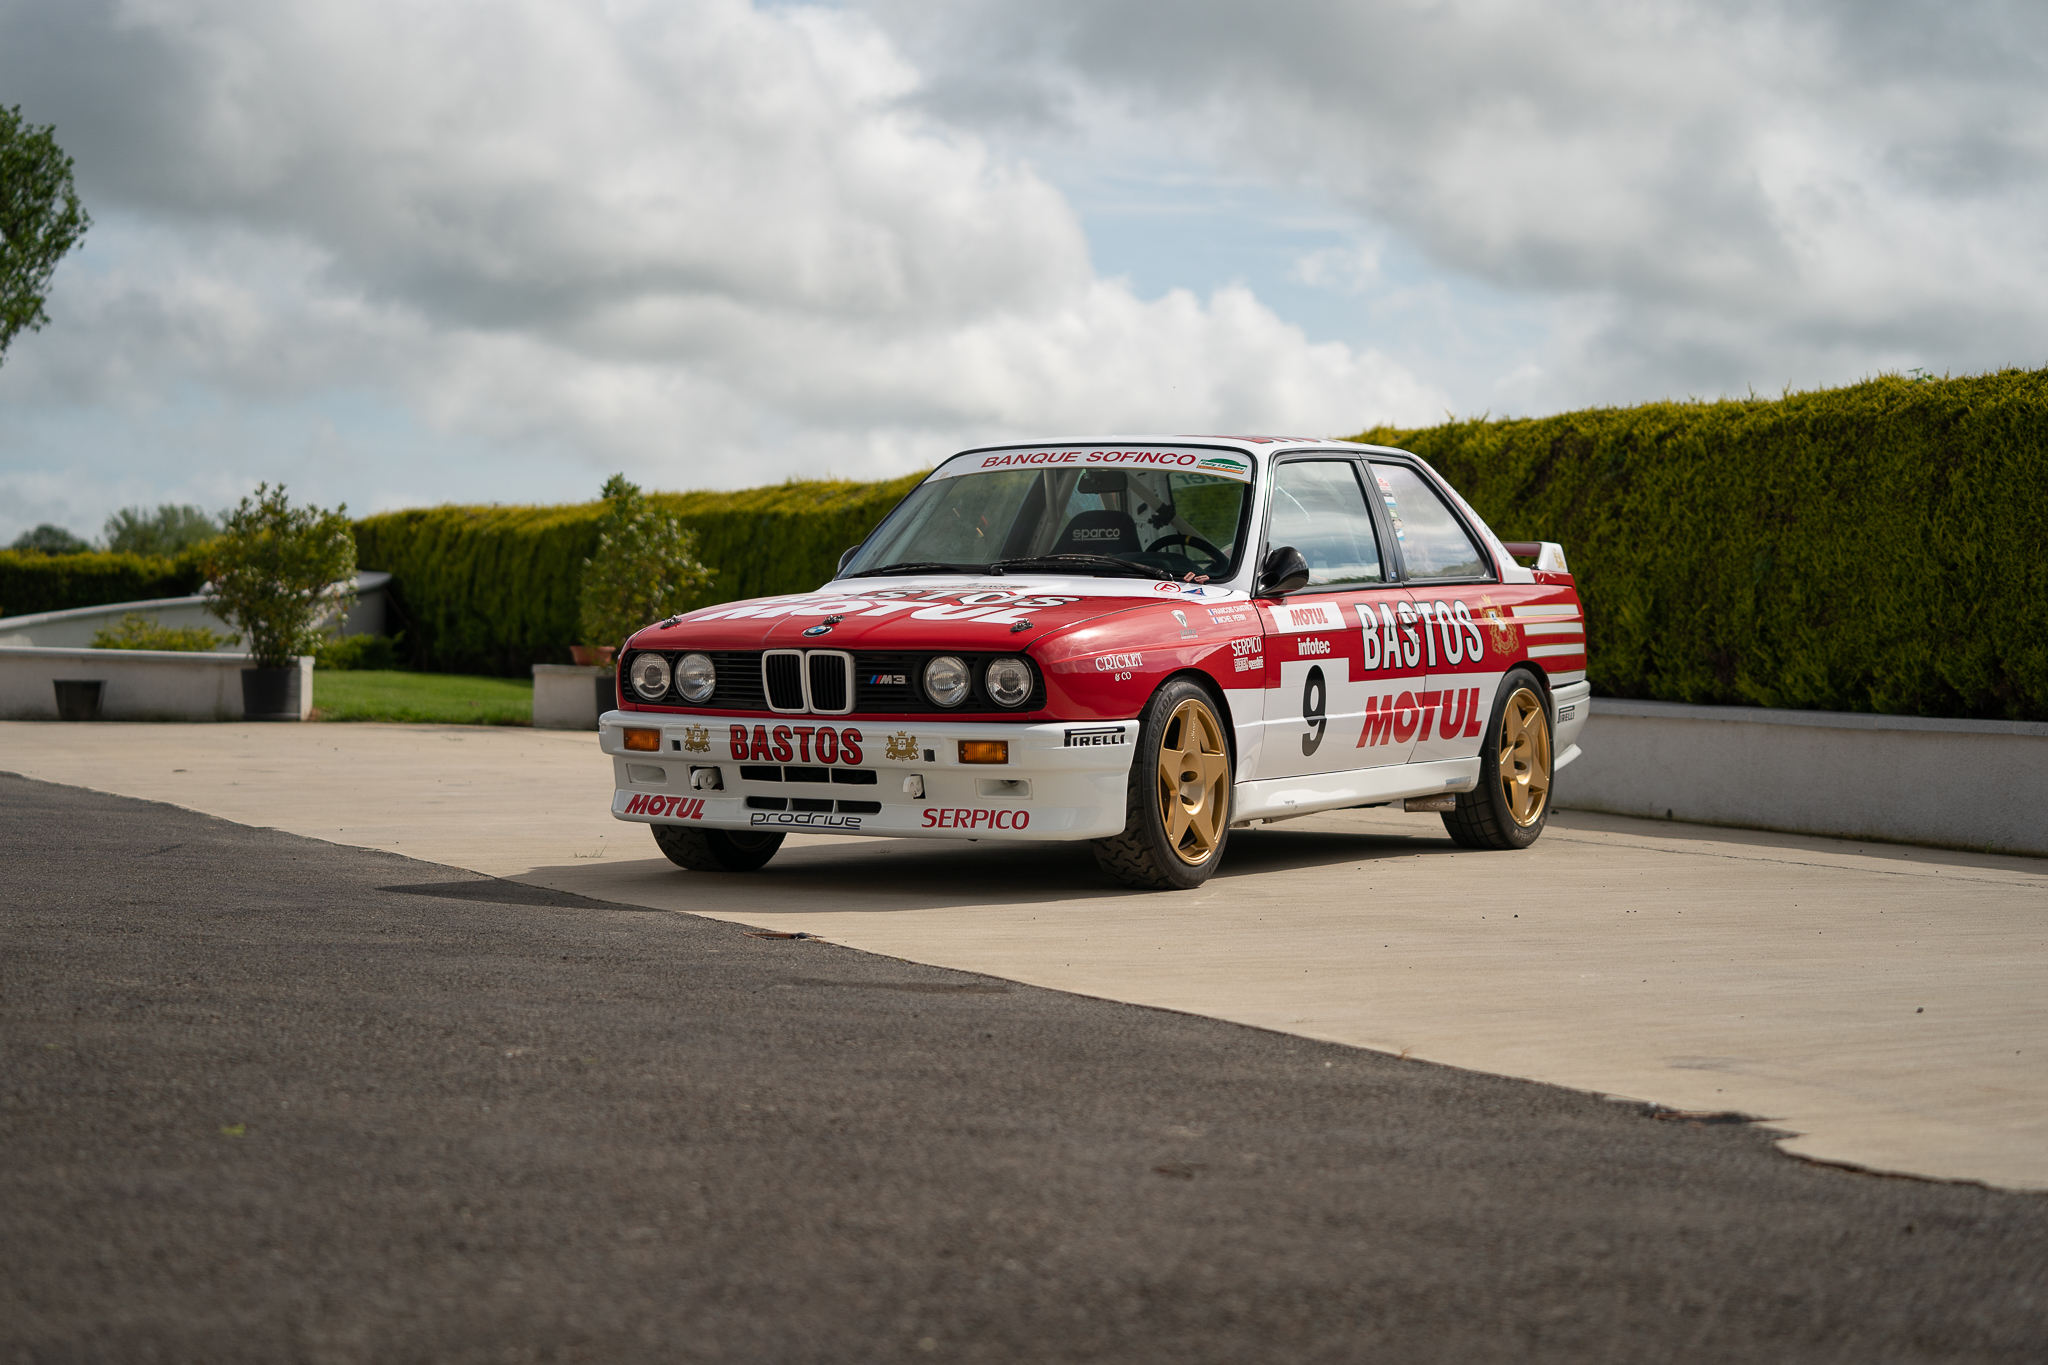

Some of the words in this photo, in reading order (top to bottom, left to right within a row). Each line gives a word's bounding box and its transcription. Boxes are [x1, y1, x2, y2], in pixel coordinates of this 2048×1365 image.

[981, 451, 1083, 468] BANQUE
[1086, 451, 1197, 466] SOFINCO
[1072, 528, 1120, 541] sparco
[688, 600, 1042, 625] MOTUL
[1290, 607, 1329, 627] MOTUL
[1354, 599, 1485, 671] BASTOS
[1231, 636, 1262, 657] SERPICO
[1297, 636, 1331, 656] infotec
[1095, 652, 1144, 671] CRICKET
[879, 674, 906, 685] M3
[1121, 671, 1132, 681] CO
[1301, 664, 1327, 757] 9
[1356, 687, 1483, 749] MOTUL
[1557, 705, 1576, 724] PIRELLI
[729, 724, 864, 766] BASTOS
[1063, 726, 1126, 748] PIRELLI
[624, 794, 706, 820] MOTUL
[751, 811, 862, 828] prodrive
[921, 807, 1030, 831] SERPICO
